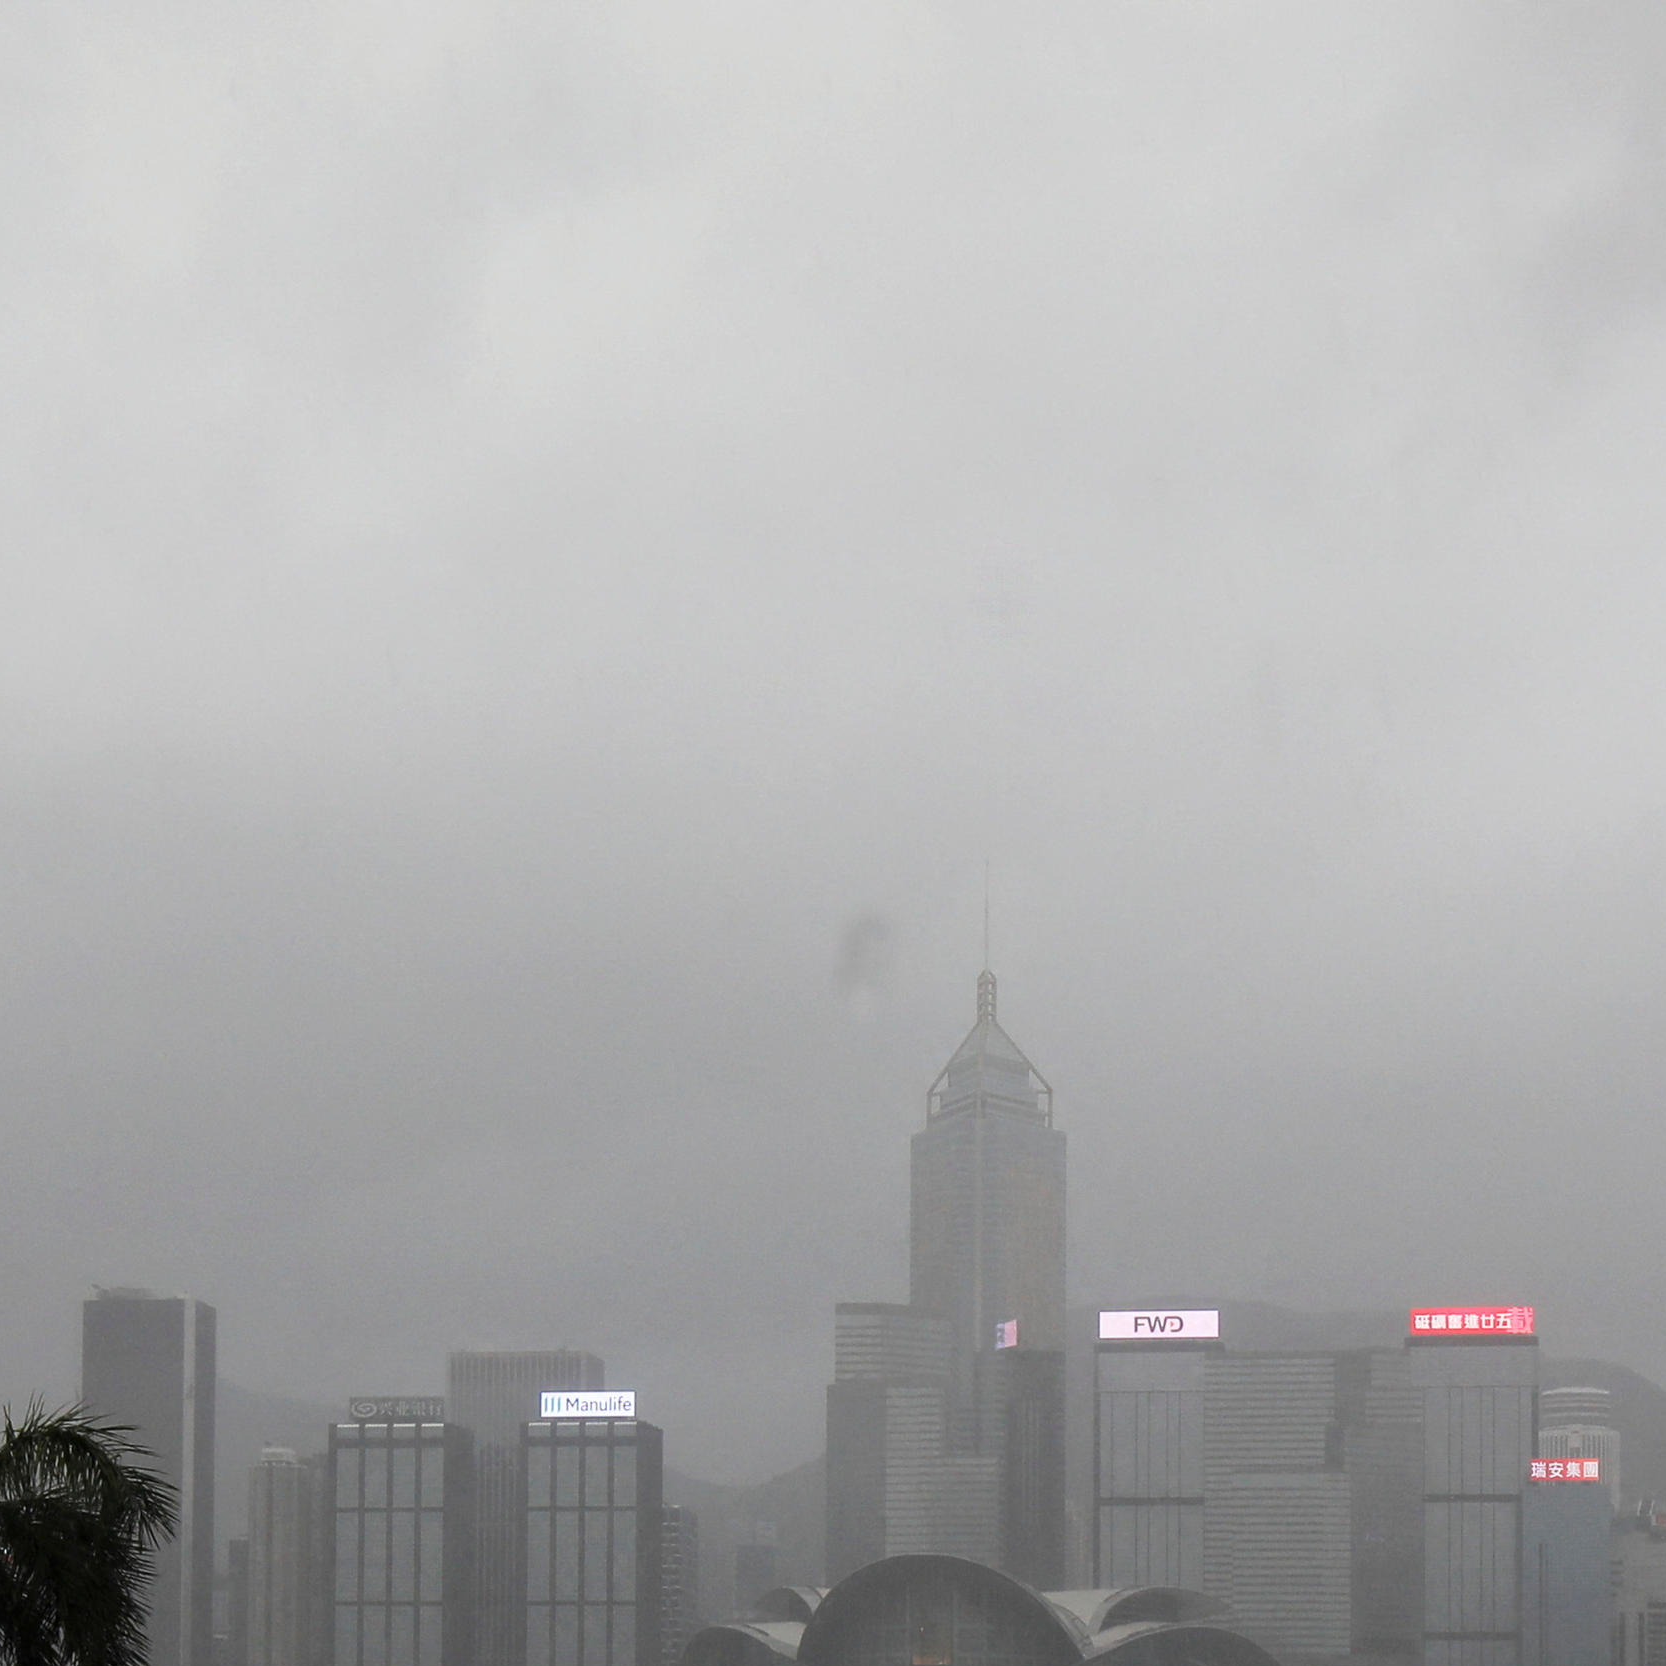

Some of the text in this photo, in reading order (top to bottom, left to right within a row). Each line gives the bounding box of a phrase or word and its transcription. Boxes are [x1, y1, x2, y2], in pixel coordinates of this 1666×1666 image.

[1134, 1316, 1184, 1333] FWD
[565, 1396, 632, 1412] Manulife
[1531, 1461, 1599, 1479] 瑞安集團
